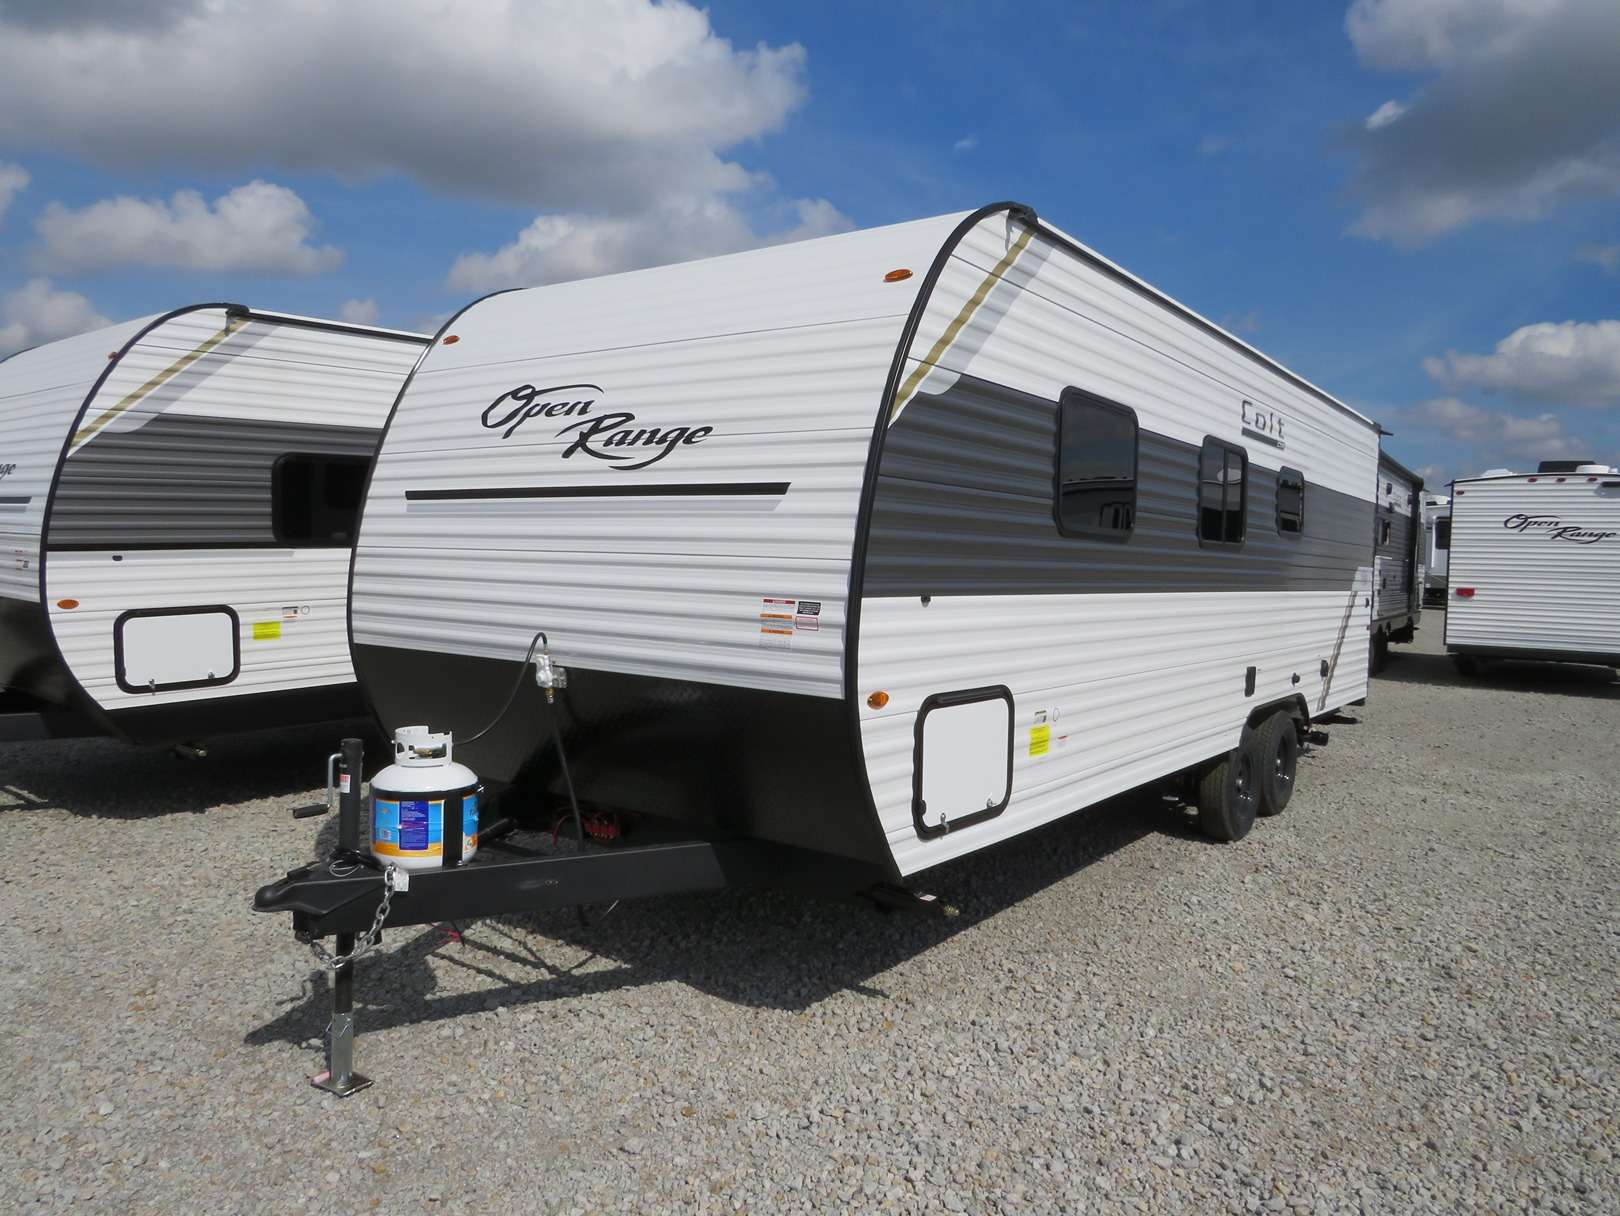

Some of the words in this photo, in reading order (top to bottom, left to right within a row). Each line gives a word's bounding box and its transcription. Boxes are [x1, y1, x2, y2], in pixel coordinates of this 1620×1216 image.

[481, 384, 605, 439] Open
[1241, 399, 1285, 440] Colt
[554, 412, 714, 471] Range
[1503, 513, 1561, 533] Open
[1547, 526, 1618, 545] Range
